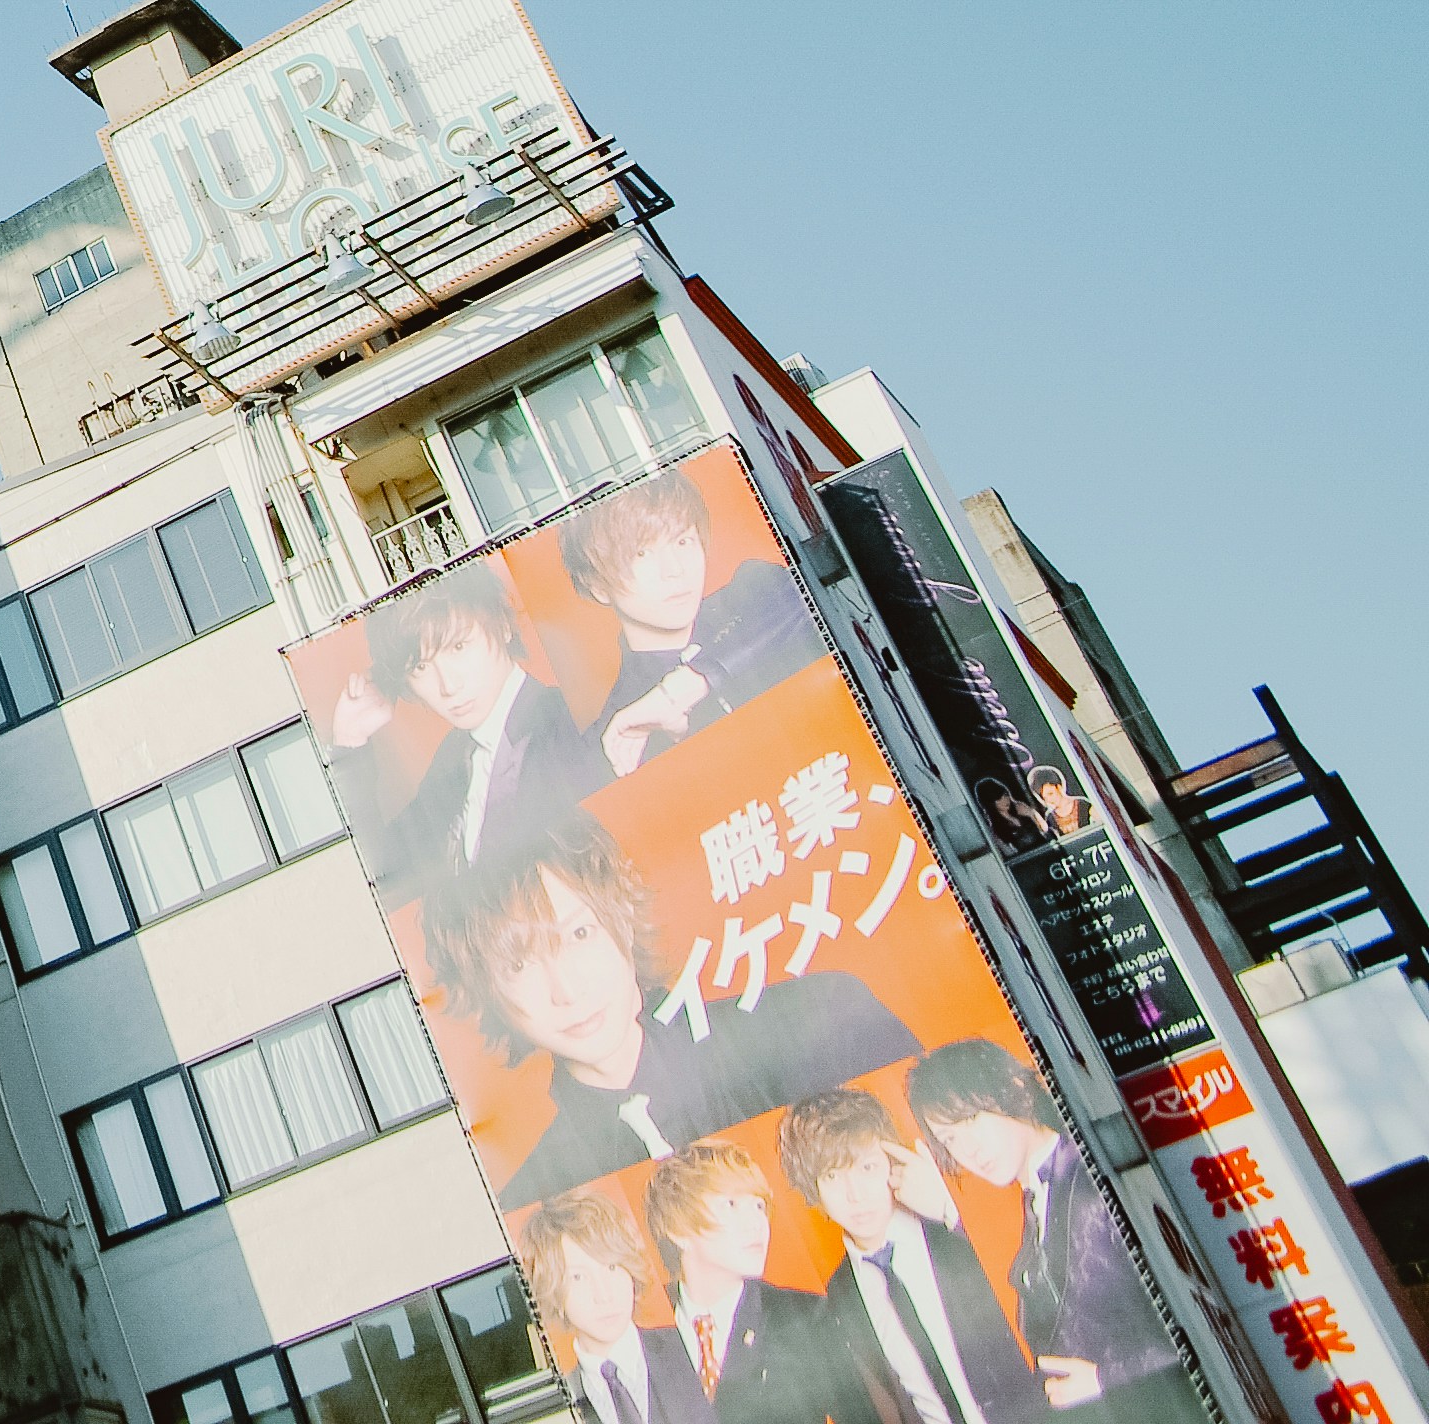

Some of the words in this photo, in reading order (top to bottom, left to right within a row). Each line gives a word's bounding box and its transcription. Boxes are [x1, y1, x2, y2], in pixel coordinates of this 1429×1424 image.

[699, 751, 896, 906] 職業、
[652, 832, 949, 1044] イケメン。
[1133, 1064, 1235, 1124] スマイル
